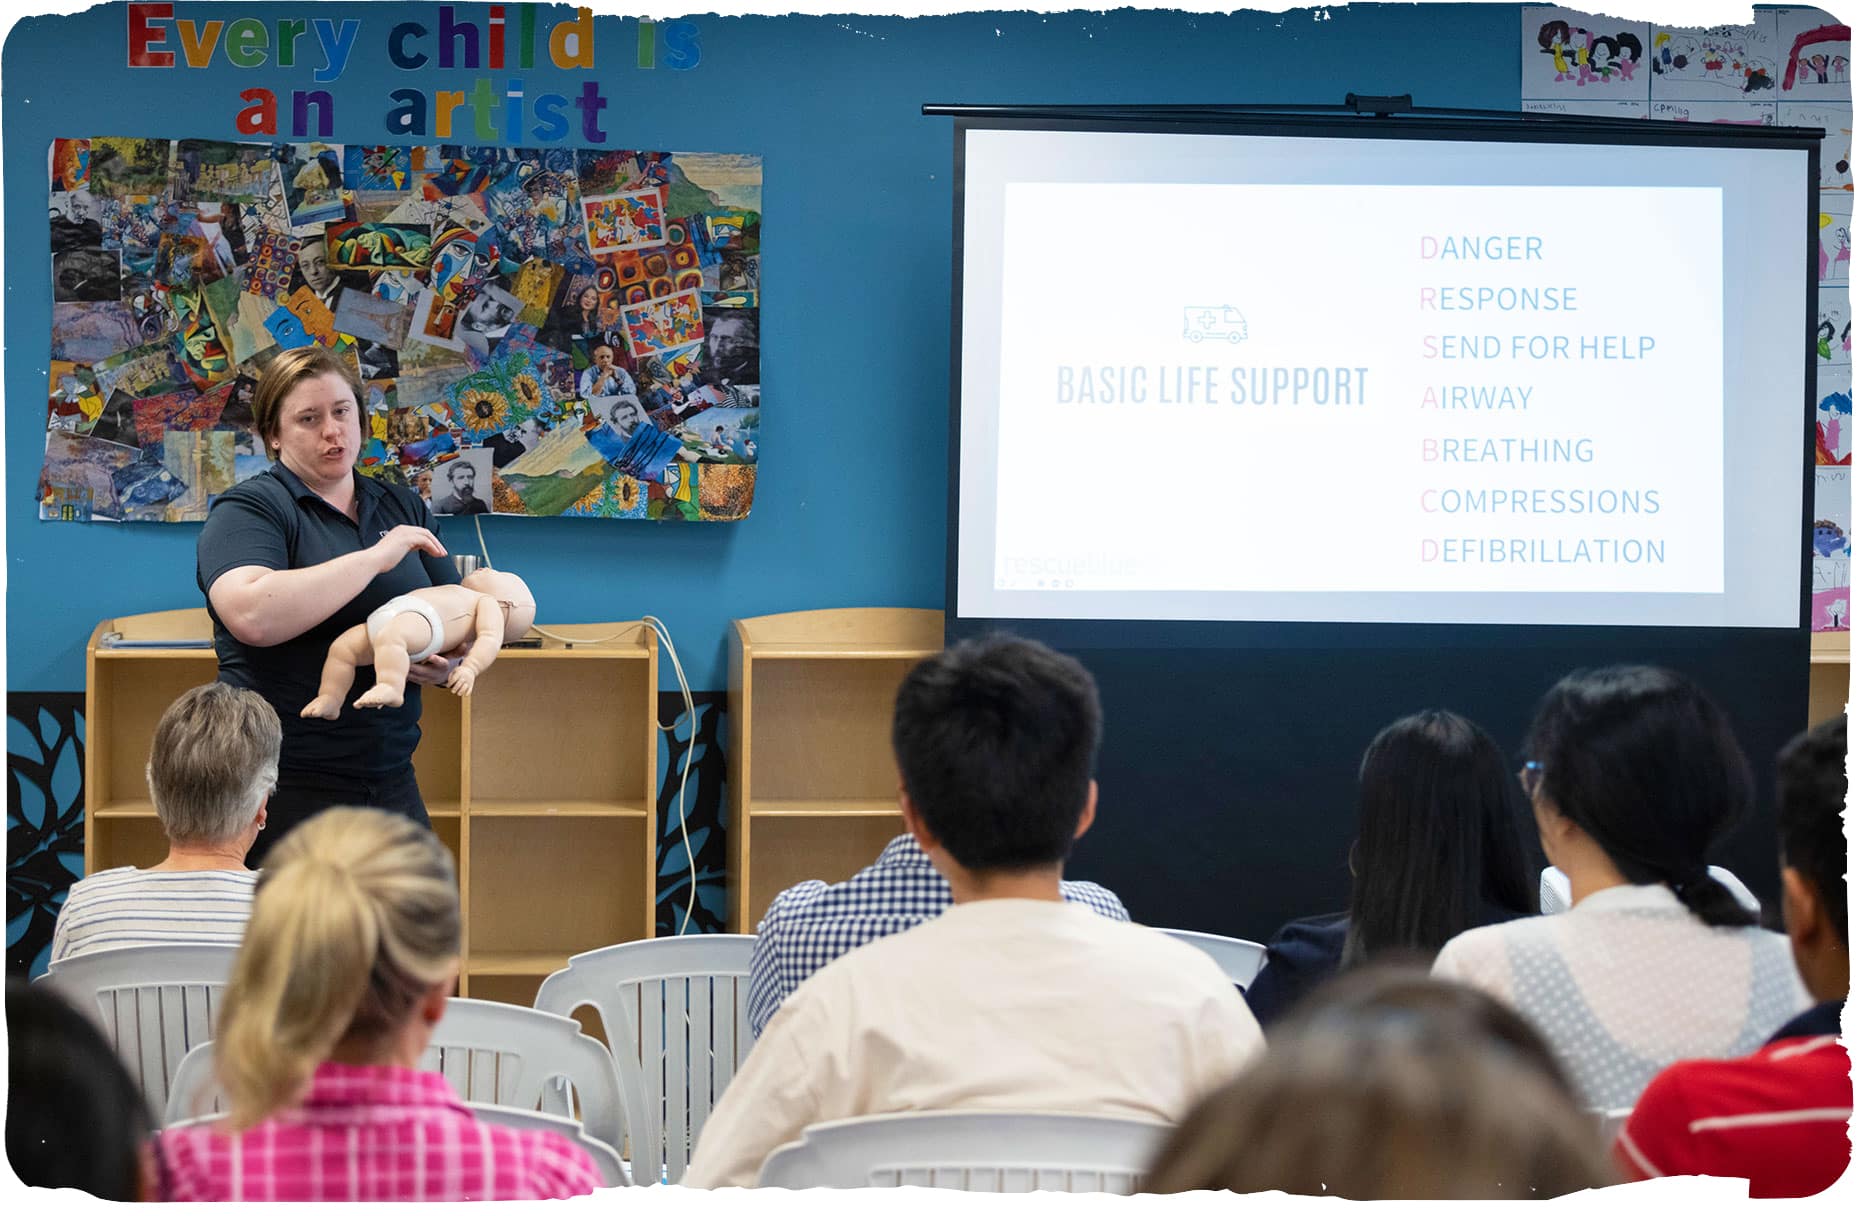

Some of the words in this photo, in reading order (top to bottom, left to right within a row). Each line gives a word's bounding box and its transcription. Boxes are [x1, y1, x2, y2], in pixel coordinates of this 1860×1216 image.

[127, 2, 361, 82] Every
[387, 4, 595, 70] child
[638, 15, 702, 70] is
[235, 86, 335, 137] an
[386, 77, 608, 143] artist
[1420, 233, 1545, 262] DANGER
[1420, 286, 1580, 313] RESPONSE
[1422, 334, 1503, 361] SEND
[1510, 334, 1572, 361] FOR
[1578, 334, 1657, 362] HELP
[1056, 365, 1148, 405] BASIC
[1158, 366, 1220, 406] LIFE
[1230, 366, 1371, 407] SUPPORT
[1420, 384, 1535, 412] AIRWAY
[1421, 437, 1596, 465] BREATHING
[1420, 488, 1664, 516] COMPRESSIONS
[1420, 537, 1667, 566] DEFIBRILLATION
